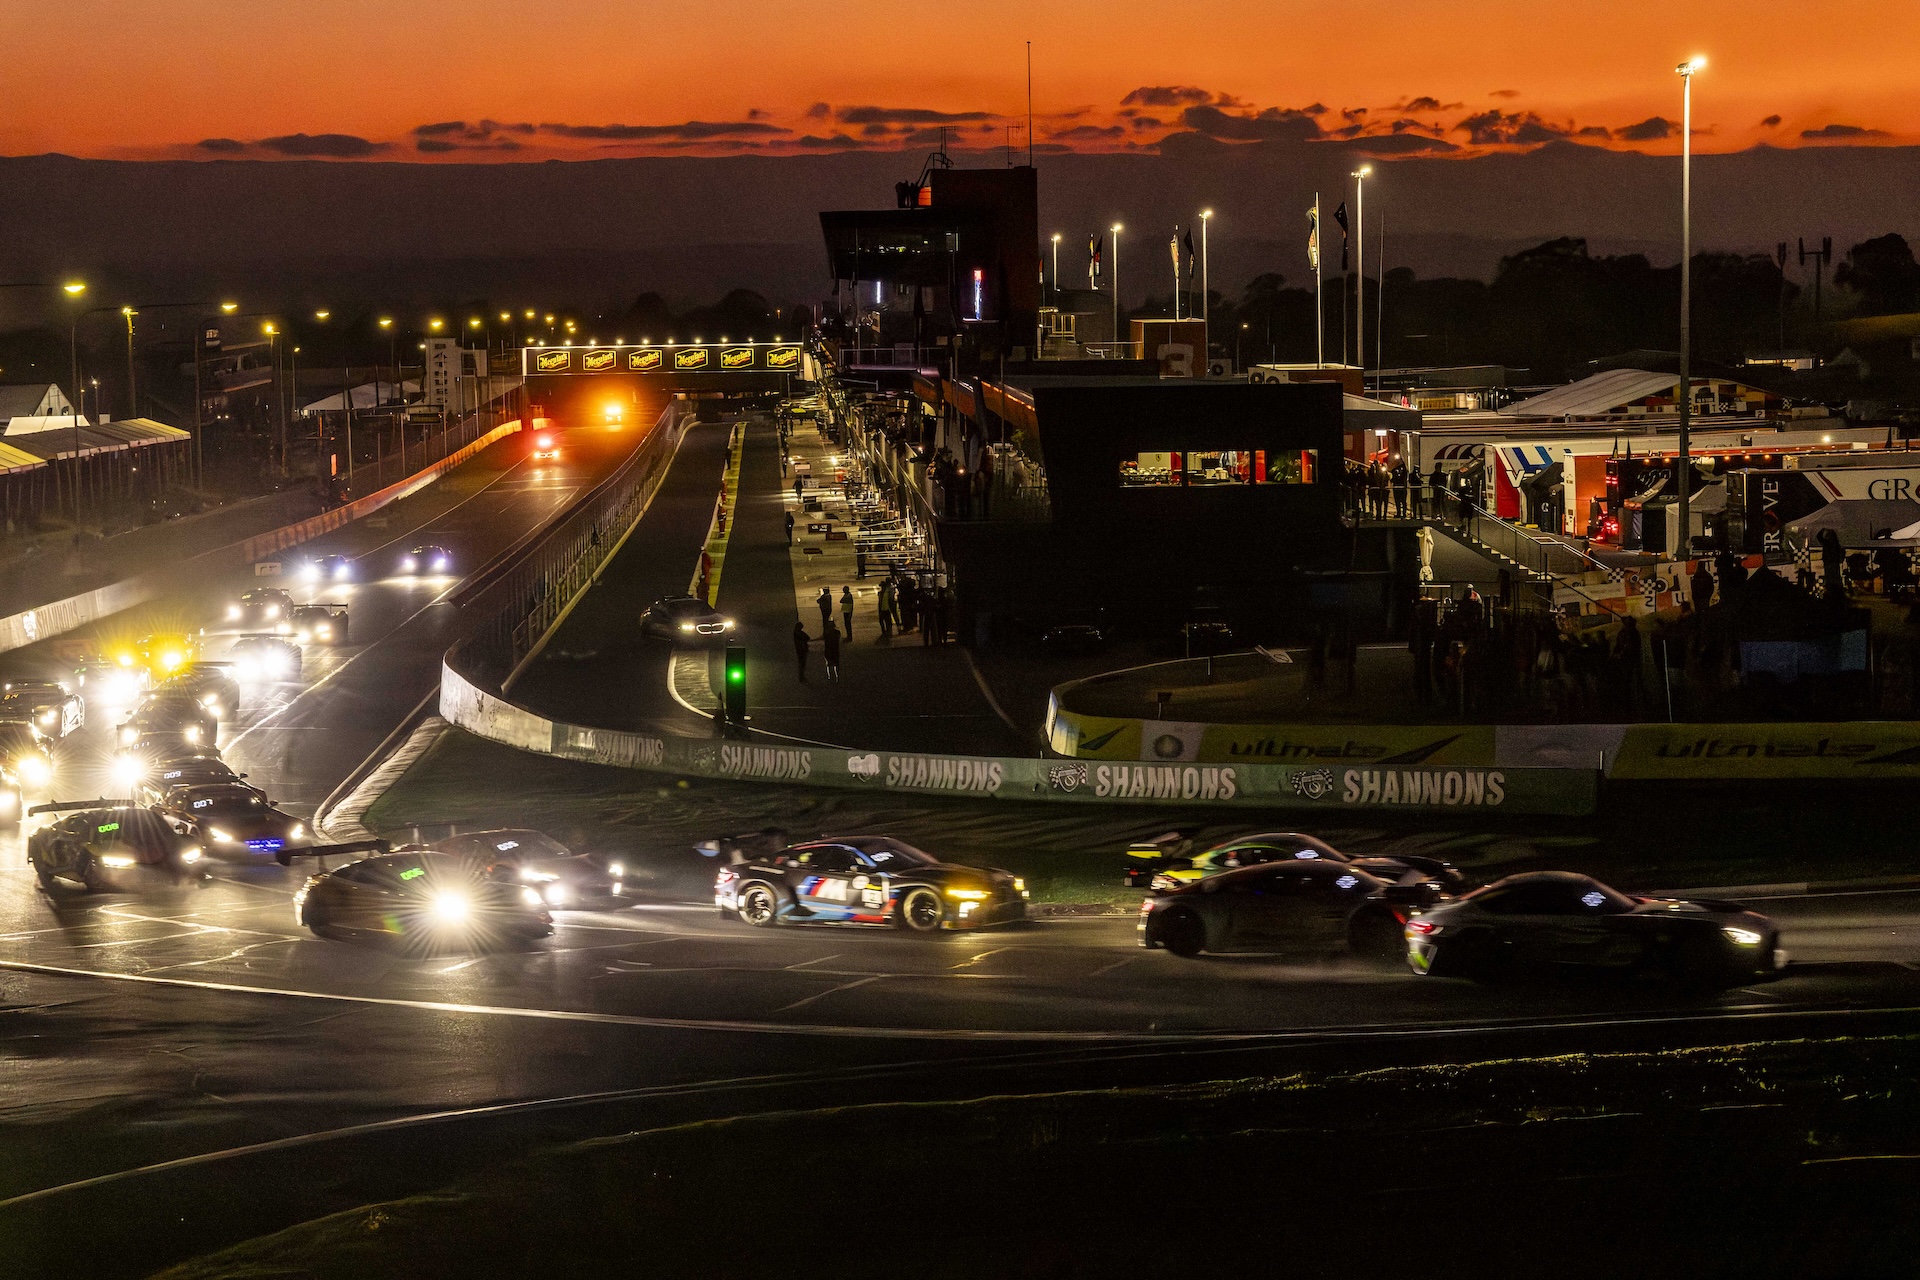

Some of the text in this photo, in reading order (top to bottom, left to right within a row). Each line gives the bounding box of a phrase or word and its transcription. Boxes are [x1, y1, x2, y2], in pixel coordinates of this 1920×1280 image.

[1868, 478, 1920, 505] GR
[718, 745, 812, 779] SHANNONS
[886, 757, 1002, 791] SHANNONS
[1095, 765, 1236, 800] SHANNONS
[1343, 769, 1505, 805] SHANNONS
[193, 799, 213, 809] 007
